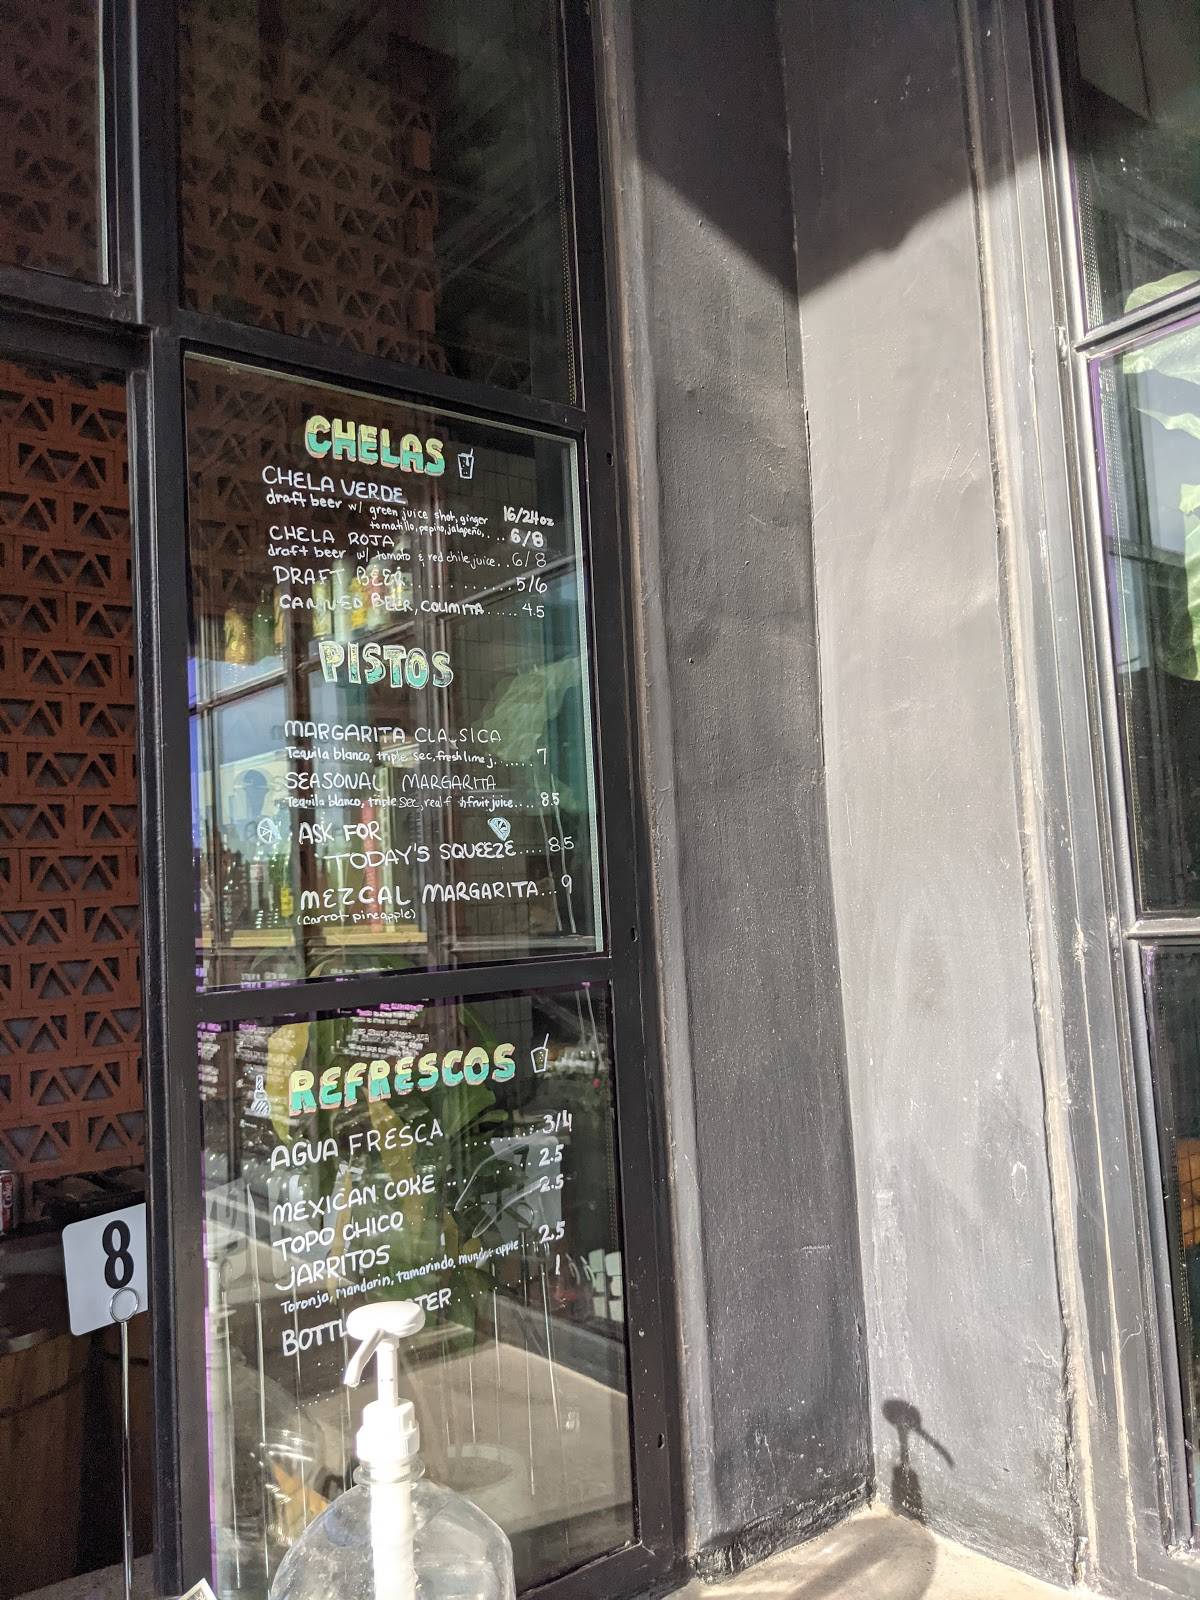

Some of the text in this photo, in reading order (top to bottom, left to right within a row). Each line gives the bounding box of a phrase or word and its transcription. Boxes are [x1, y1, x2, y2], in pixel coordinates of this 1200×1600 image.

[305, 415, 445, 476] CHELAS
[262, 465, 407, 504] CHELA VERDE
[266, 488, 306, 507] draft
[310, 493, 342, 508] beer
[348, 501, 362, 513] w/
[369, 506, 398, 520] green
[402, 508, 428, 520] juice
[460, 514, 488, 527] ginger
[269, 525, 395, 547] CHELA ROJA
[510, 528, 544, 547] 6/8
[268, 543, 308, 557] draft
[313, 546, 346, 559] beer
[356, 547, 369, 562] w/
[375, 547, 411, 561] tomato
[427, 551, 443, 562] red
[446, 550, 470, 564] chile
[272, 565, 548, 593] DRAFT BEER 5/6
[521, 602, 545, 618] 4.5
[318, 640, 454, 690] PISTOS
[284, 720, 502, 744] MARGARITA CLASICA
[285, 746, 330, 761] Tequila
[376, 750, 409, 764] triple
[437, 751, 462, 763] fresh
[463, 751, 485, 764] lime
[536, 747, 547, 766] 7
[284, 771, 497, 793] SEASONAL MARGARITA
[285, 795, 326, 809] Tequila
[367, 798, 397, 812] triple
[423, 795, 443, 808] real
[298, 820, 383, 845] ASK FOR
[321, 842, 431, 872] TODAY'S
[439, 840, 517, 861] SQUEEZE
[300, 874, 573, 911] MEZCAL MARGARITA 9
[352, 908, 416, 923] pineapple)
[288, 1042, 516, 1116] REFRESCOS
[270, 1109, 573, 1171] AGUA FRESCA 3/4
[272, 1144, 565, 1226] MEXICAN COKE 2.5
[272, 1174, 565, 1262] TOPO CHICO 2.5
[102, 1219, 134, 1289] 8
[274, 1221, 566, 1292] JARRITOS 2.5
[335, 1273, 395, 1300] mandarin,
[495, 1240, 519, 1257] apple
